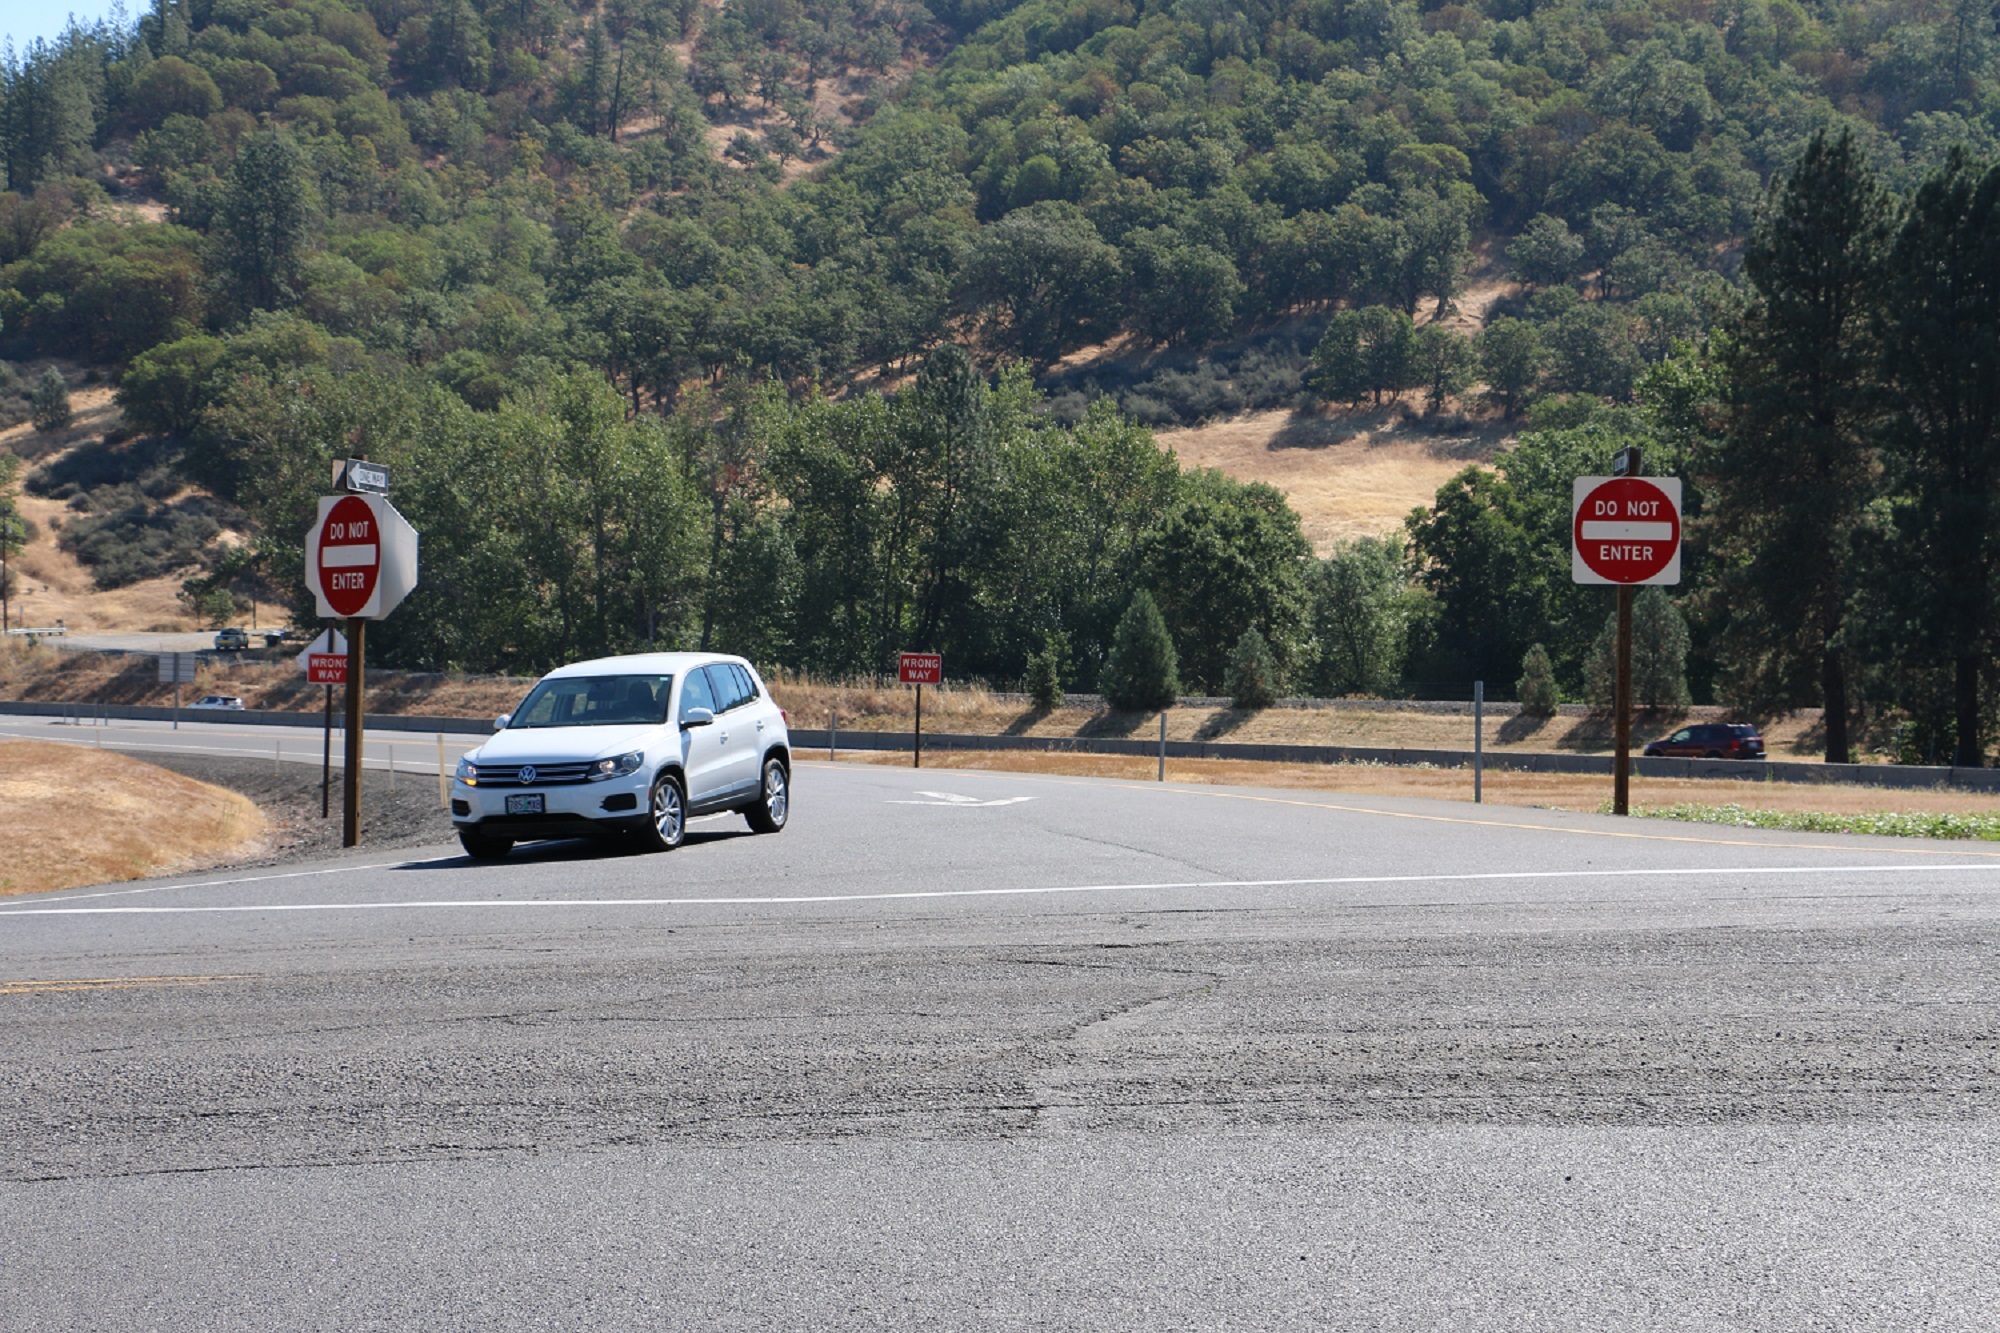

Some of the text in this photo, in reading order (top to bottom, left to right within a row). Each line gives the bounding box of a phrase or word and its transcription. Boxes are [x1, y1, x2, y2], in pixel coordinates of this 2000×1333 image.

[1595, 501, 1660, 516] DO NOT
[330, 521, 369, 539] DO NOT
[1600, 545, 1653, 560] ENTER
[332, 572, 365, 590] ENTER
[902, 658, 938, 668] WRONG
[318, 670, 341, 680] WAY
[909, 670, 931, 680] WAY
